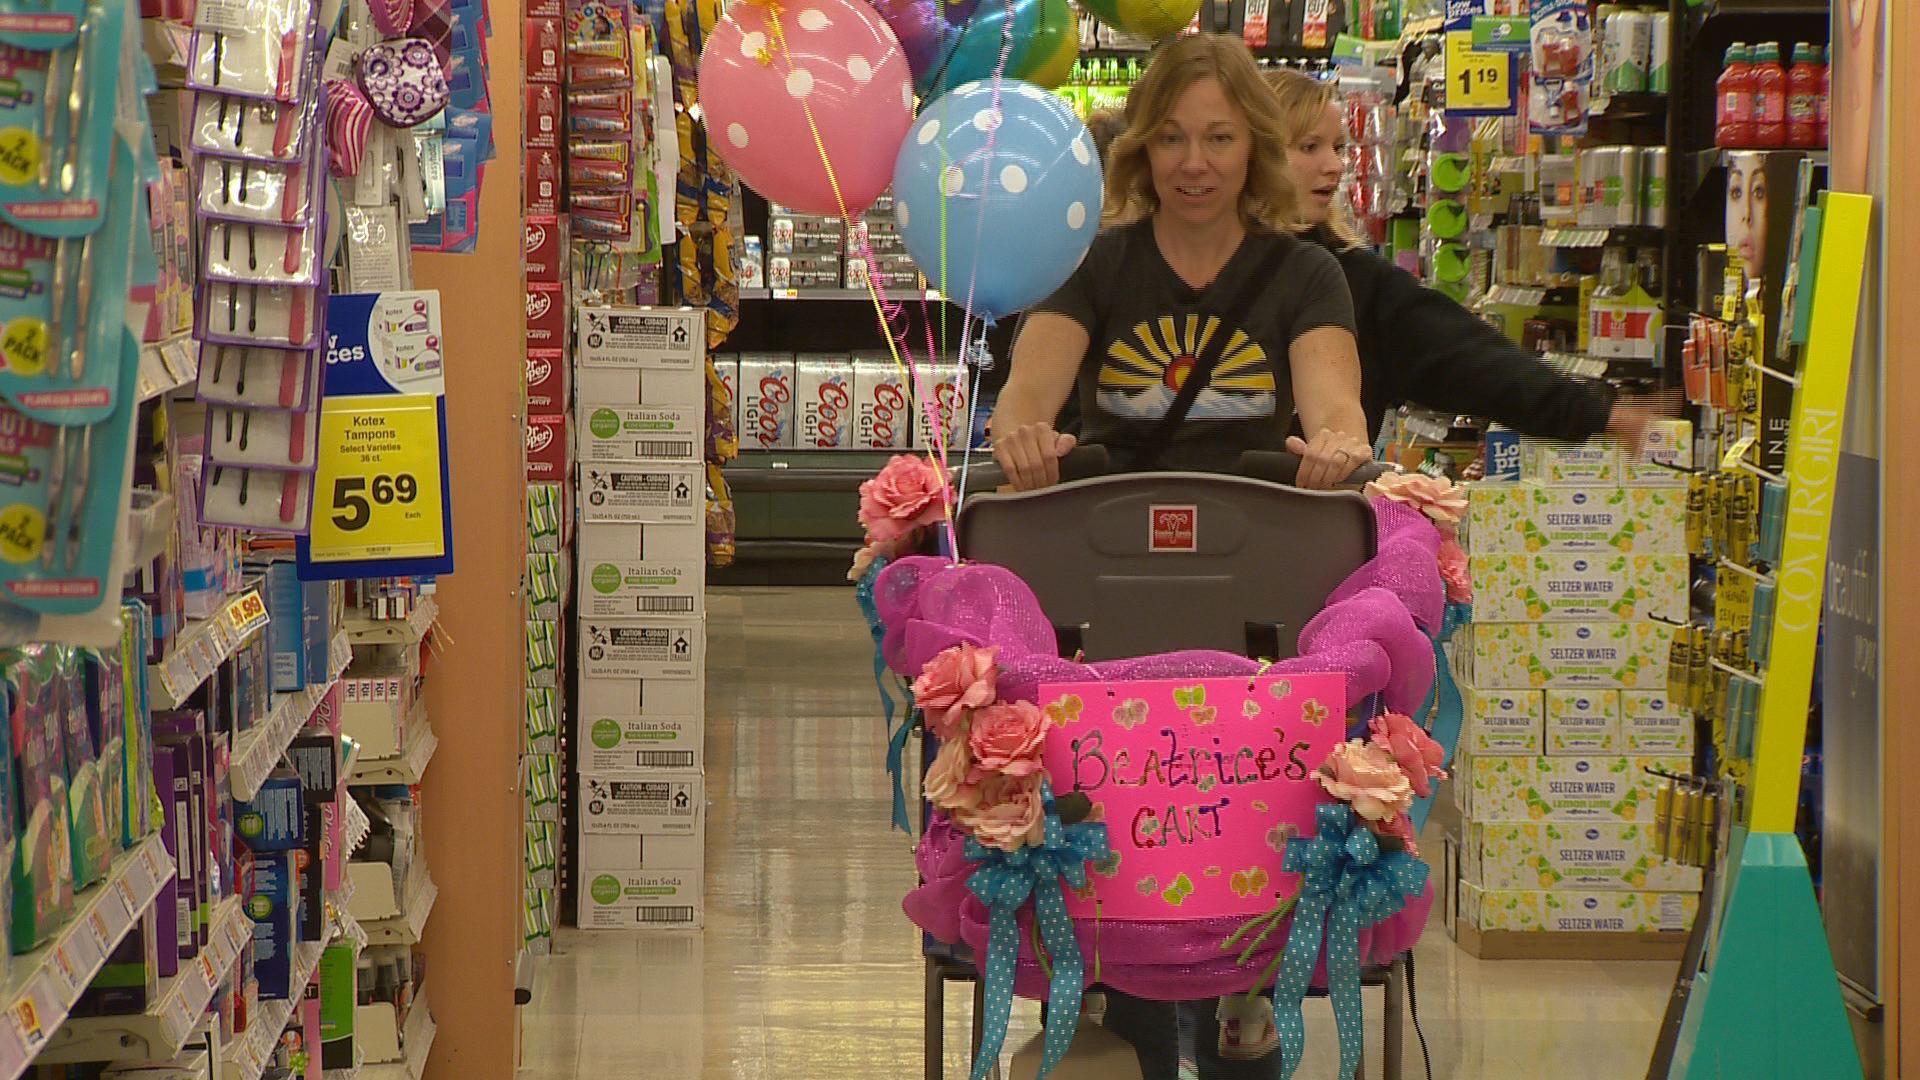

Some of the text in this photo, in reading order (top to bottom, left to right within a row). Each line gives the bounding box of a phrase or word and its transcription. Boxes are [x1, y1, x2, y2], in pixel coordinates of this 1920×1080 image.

[1458, 68, 1498, 95] 1 19
[326, 345, 364, 364] ces
[353, 416, 385, 427] Kotex
[627, 411, 681, 421] Italian Soda
[746, 395, 758, 439] LIGHT
[805, 401, 818, 445] LIGHT
[860, 402, 873, 445] LIGHT
[344, 430, 396, 442] Tampons
[340, 444, 401, 454] Select Varieties
[1493, 441, 1520, 457] Lo
[360, 454, 371, 463] 36
[331, 473, 418, 533] 5 69
[405, 511, 421, 520] Each
[1547, 513, 1612, 526] SELTZER WATER
[1778, 407, 1838, 633] COVERGIRL
[628, 567, 682, 576] Italian Soda
[1548, 581, 1613, 592] SELTZER WATER
[1551, 648, 1616, 659] SELTZER WATER
[628, 722, 682, 730] Italian Soda
[1069, 726, 1311, 792] Beatrice's
[1549, 782, 1616, 793] SELTZER WATER
[1131, 797, 1230, 849] CART
[1560, 849, 1625, 861] SELTZER WATER
[628, 877, 682, 886] Italian Soda
[1558, 918, 1624, 930] SELTZER WATER
